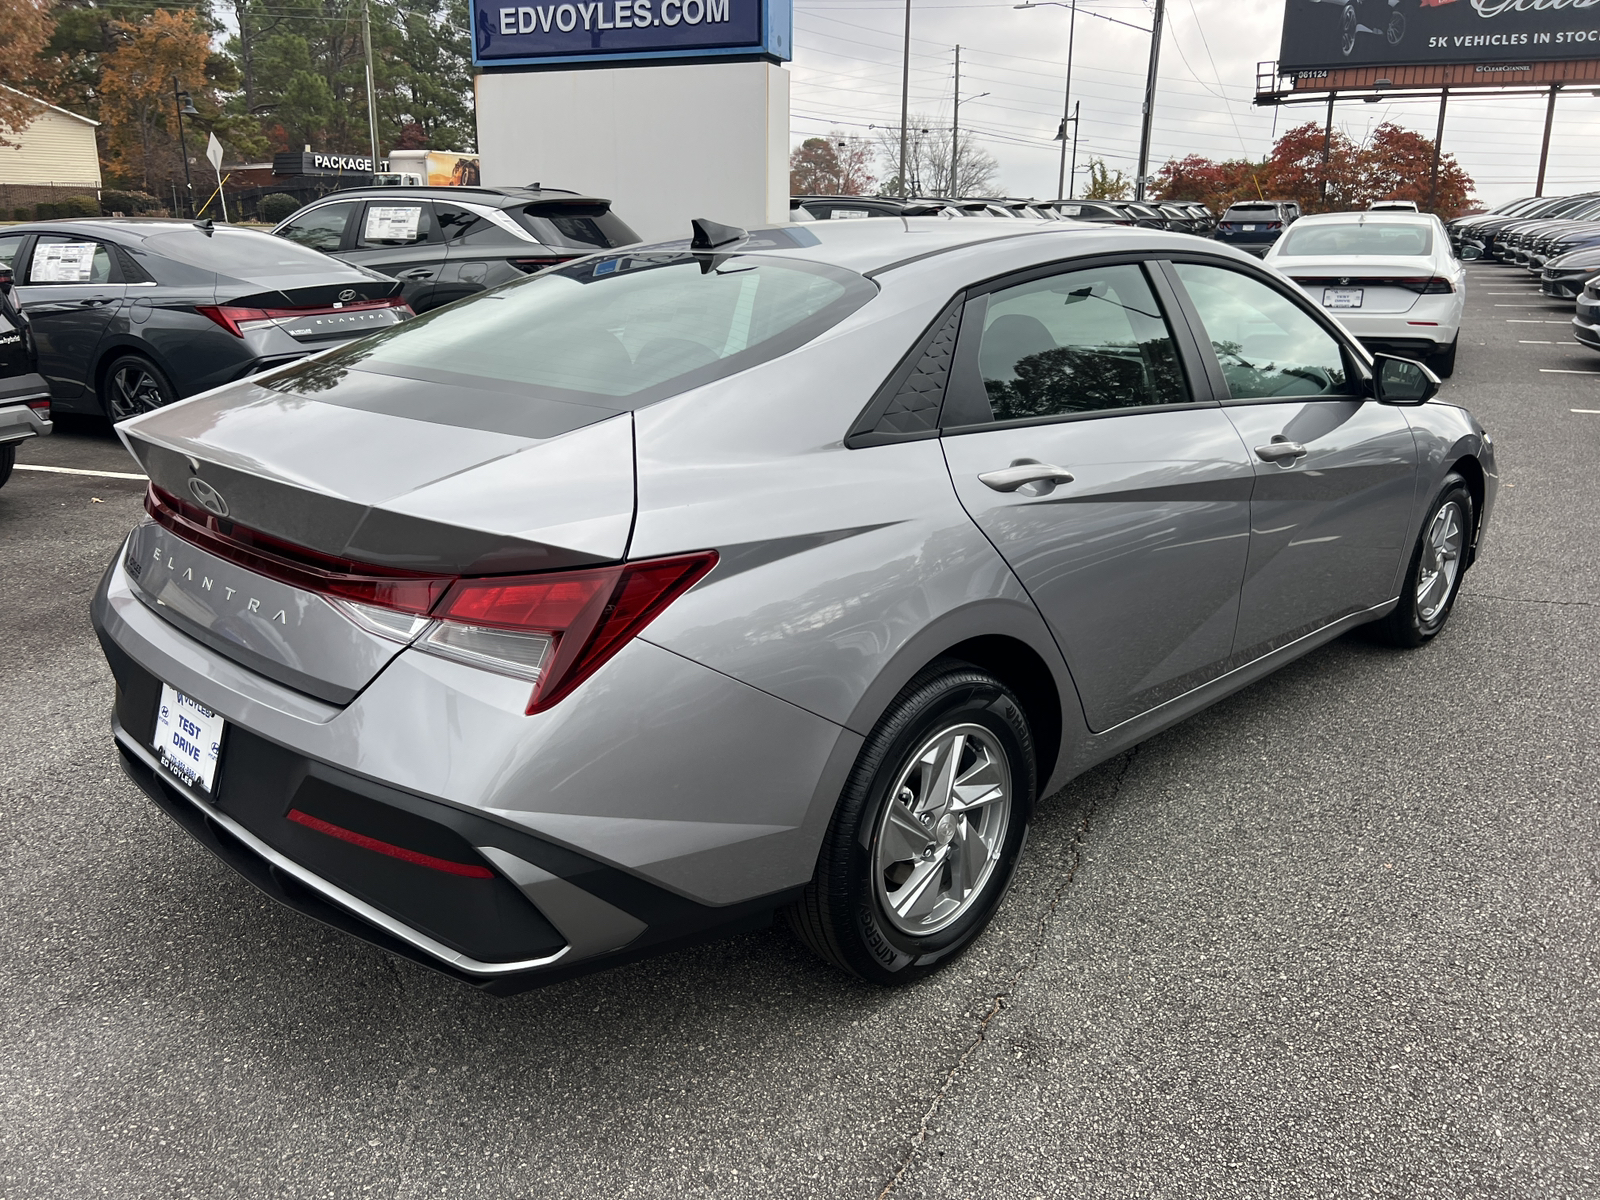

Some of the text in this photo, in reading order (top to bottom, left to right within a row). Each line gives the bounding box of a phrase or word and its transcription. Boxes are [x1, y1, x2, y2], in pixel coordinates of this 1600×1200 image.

[499, 0, 729, 35] EDVOYLES.COM
[1428, 30, 1600, 48] 5K VEHICLES IN STOC
[1298, 70, 1327, 79] 061124
[314, 155, 372, 171] PACKAGE
[316, 313, 384, 325] ELANTRA
[153, 547, 287, 625] ELANTRA
[179, 714, 201, 740] TEST
[173, 731, 201, 762] DRIVE
[169, 764, 193, 787] VOYLES
